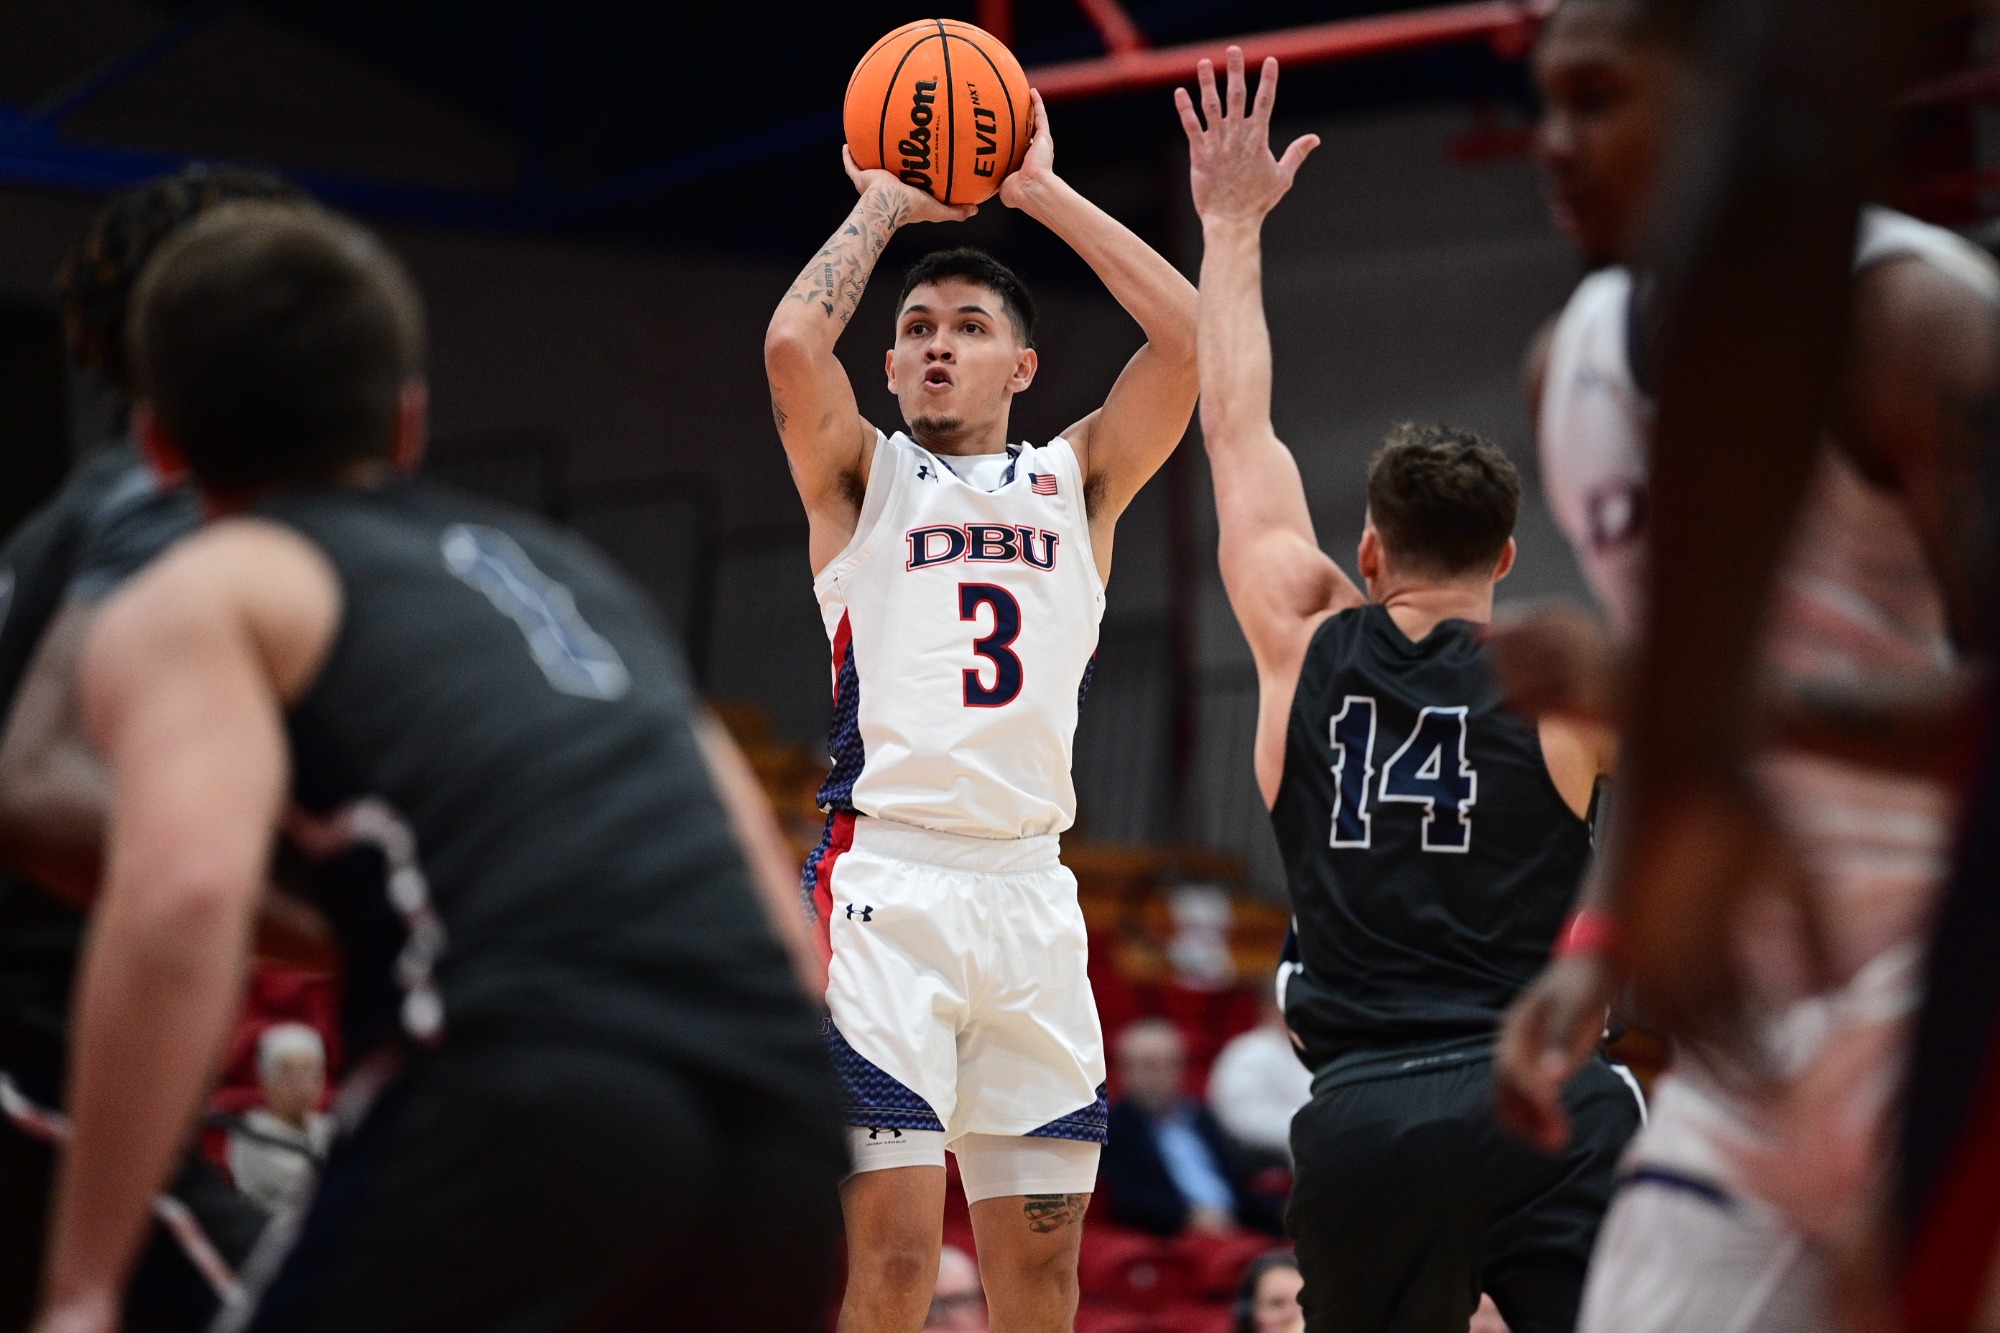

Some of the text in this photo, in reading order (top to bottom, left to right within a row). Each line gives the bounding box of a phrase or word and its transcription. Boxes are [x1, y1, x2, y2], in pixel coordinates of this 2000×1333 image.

[966, 81, 997, 178] EVO NXT
[906, 523, 1060, 572] DBU
[958, 582, 1024, 708] 3
[1329, 695, 1478, 853] 14
